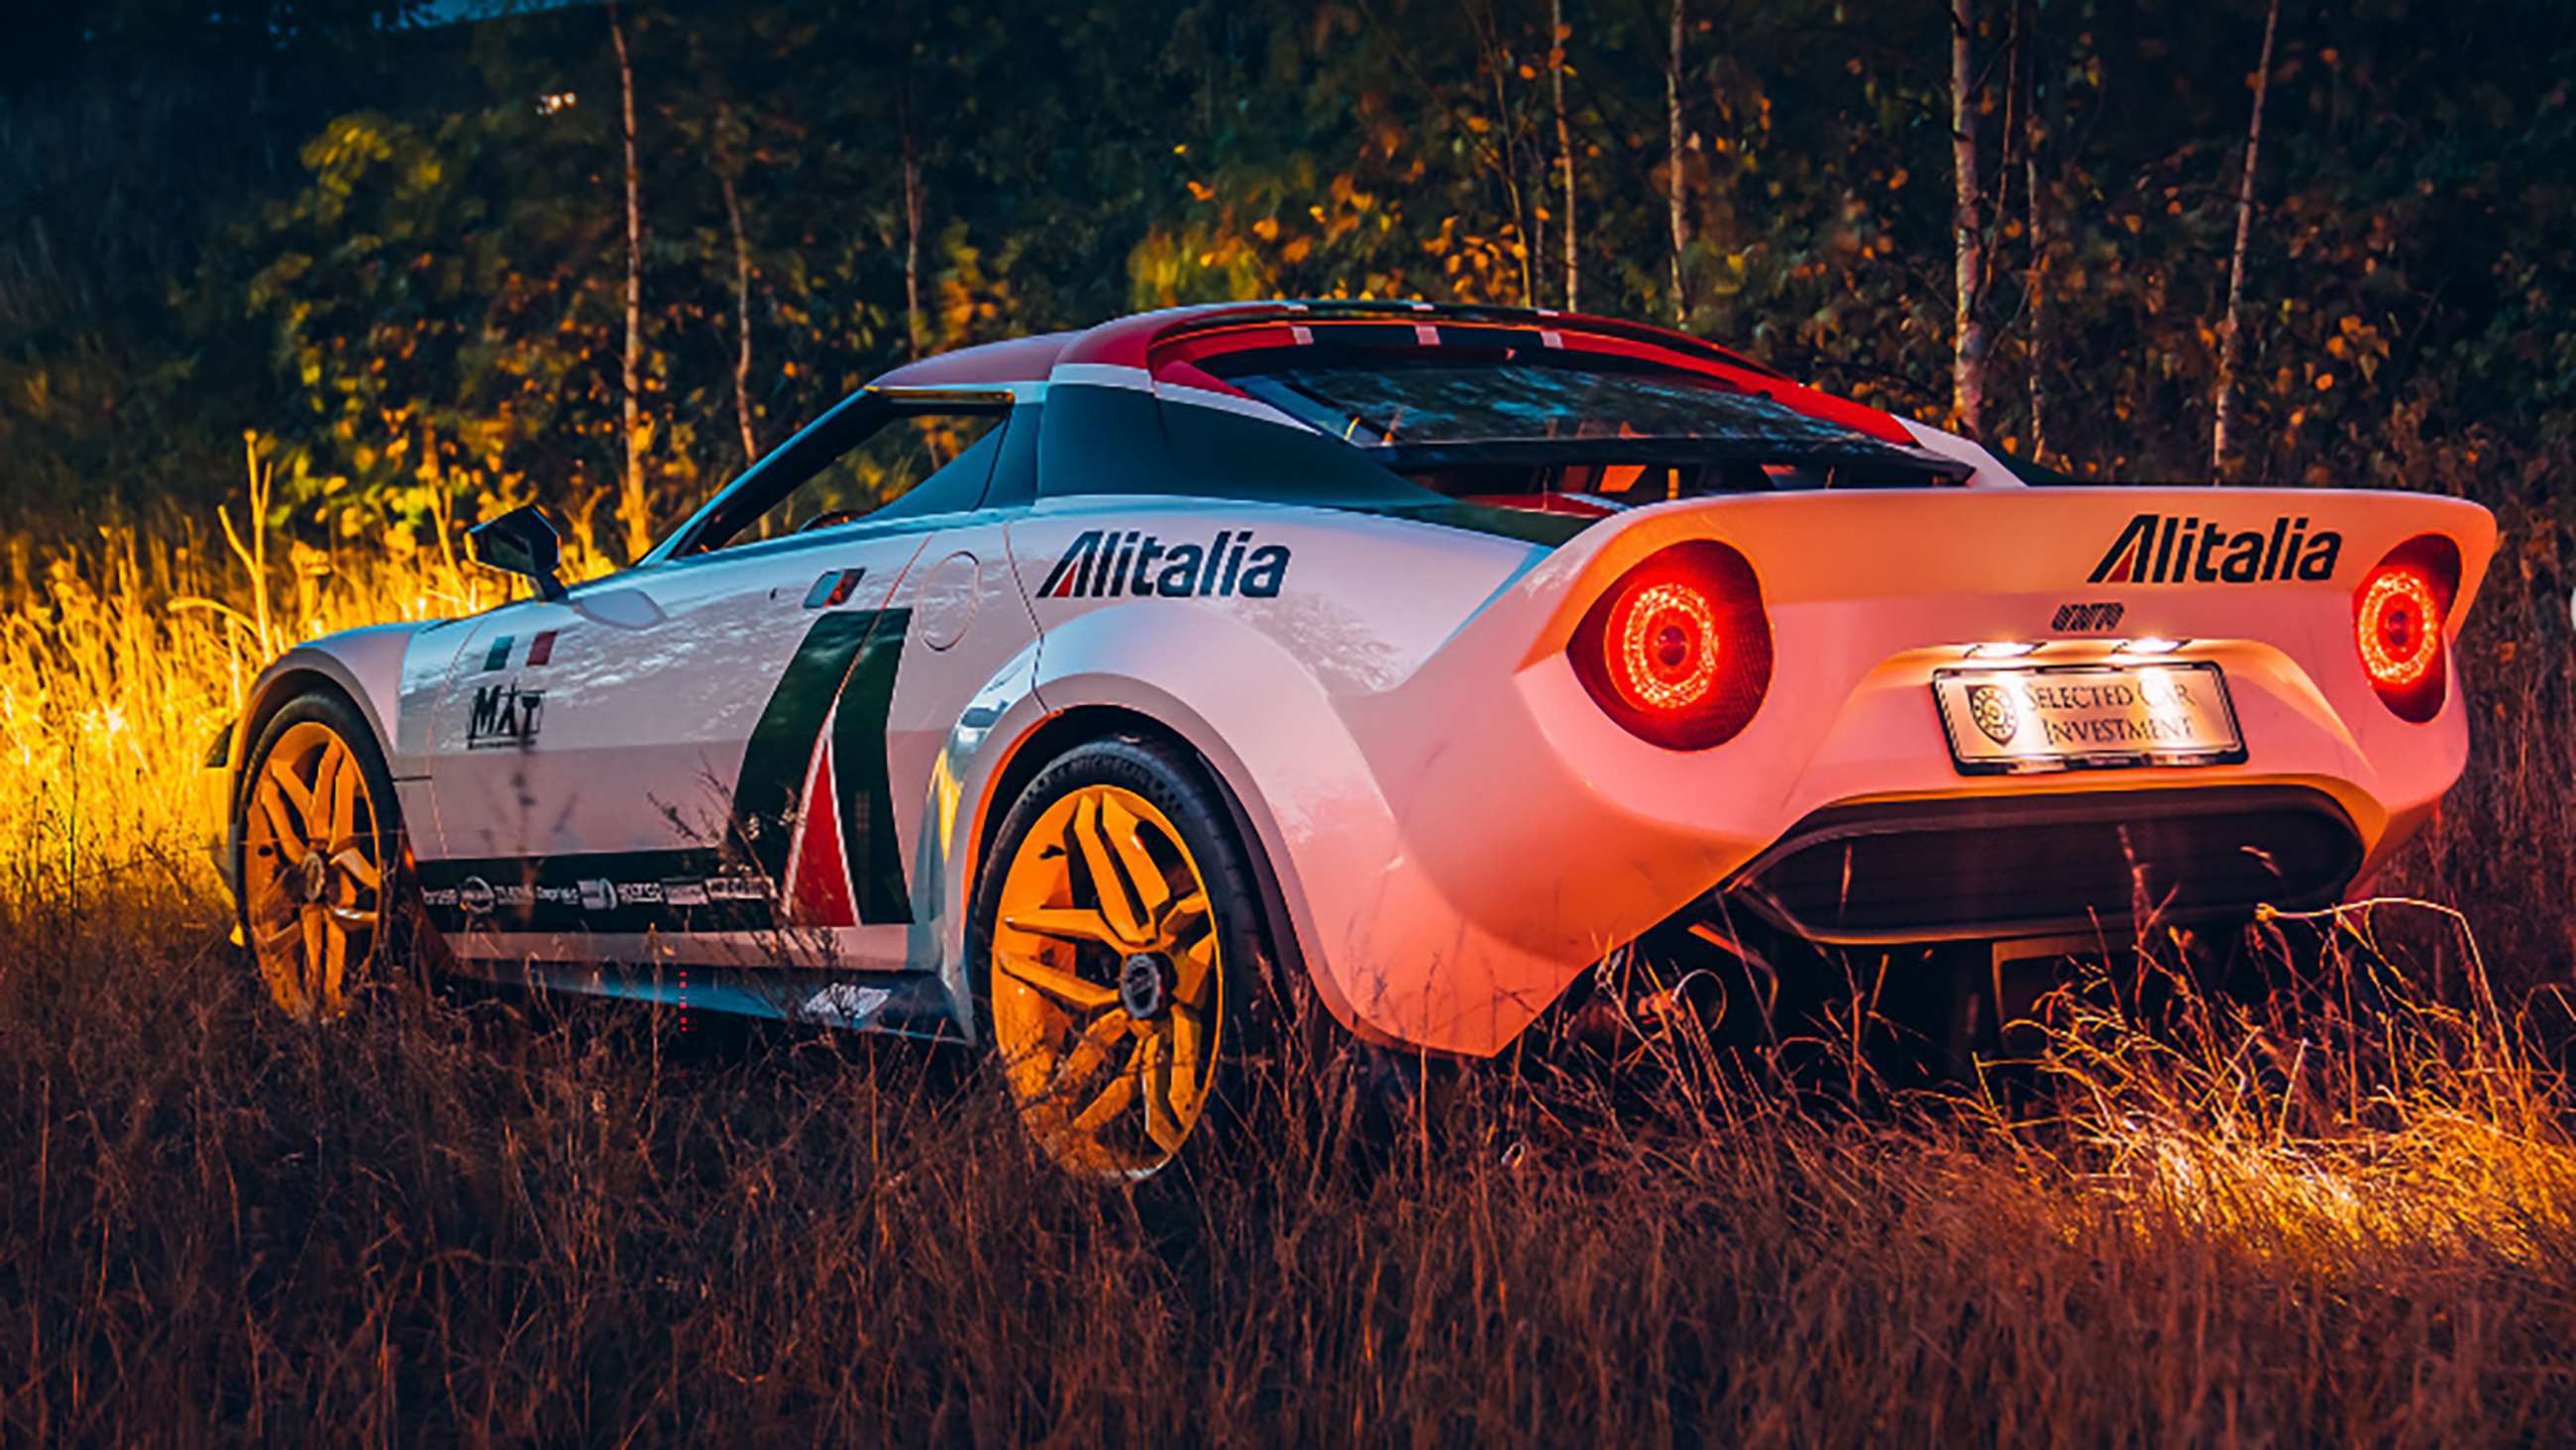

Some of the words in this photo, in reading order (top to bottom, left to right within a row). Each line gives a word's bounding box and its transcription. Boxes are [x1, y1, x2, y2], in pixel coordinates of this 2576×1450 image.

[1036, 530, 1292, 598] Alitalia
[2088, 514, 2342, 583] Alitalia
[466, 683, 546, 739] MAT
[2024, 682, 2134, 711] SELECTED
[2042, 718, 2195, 746] INVESTMENT
